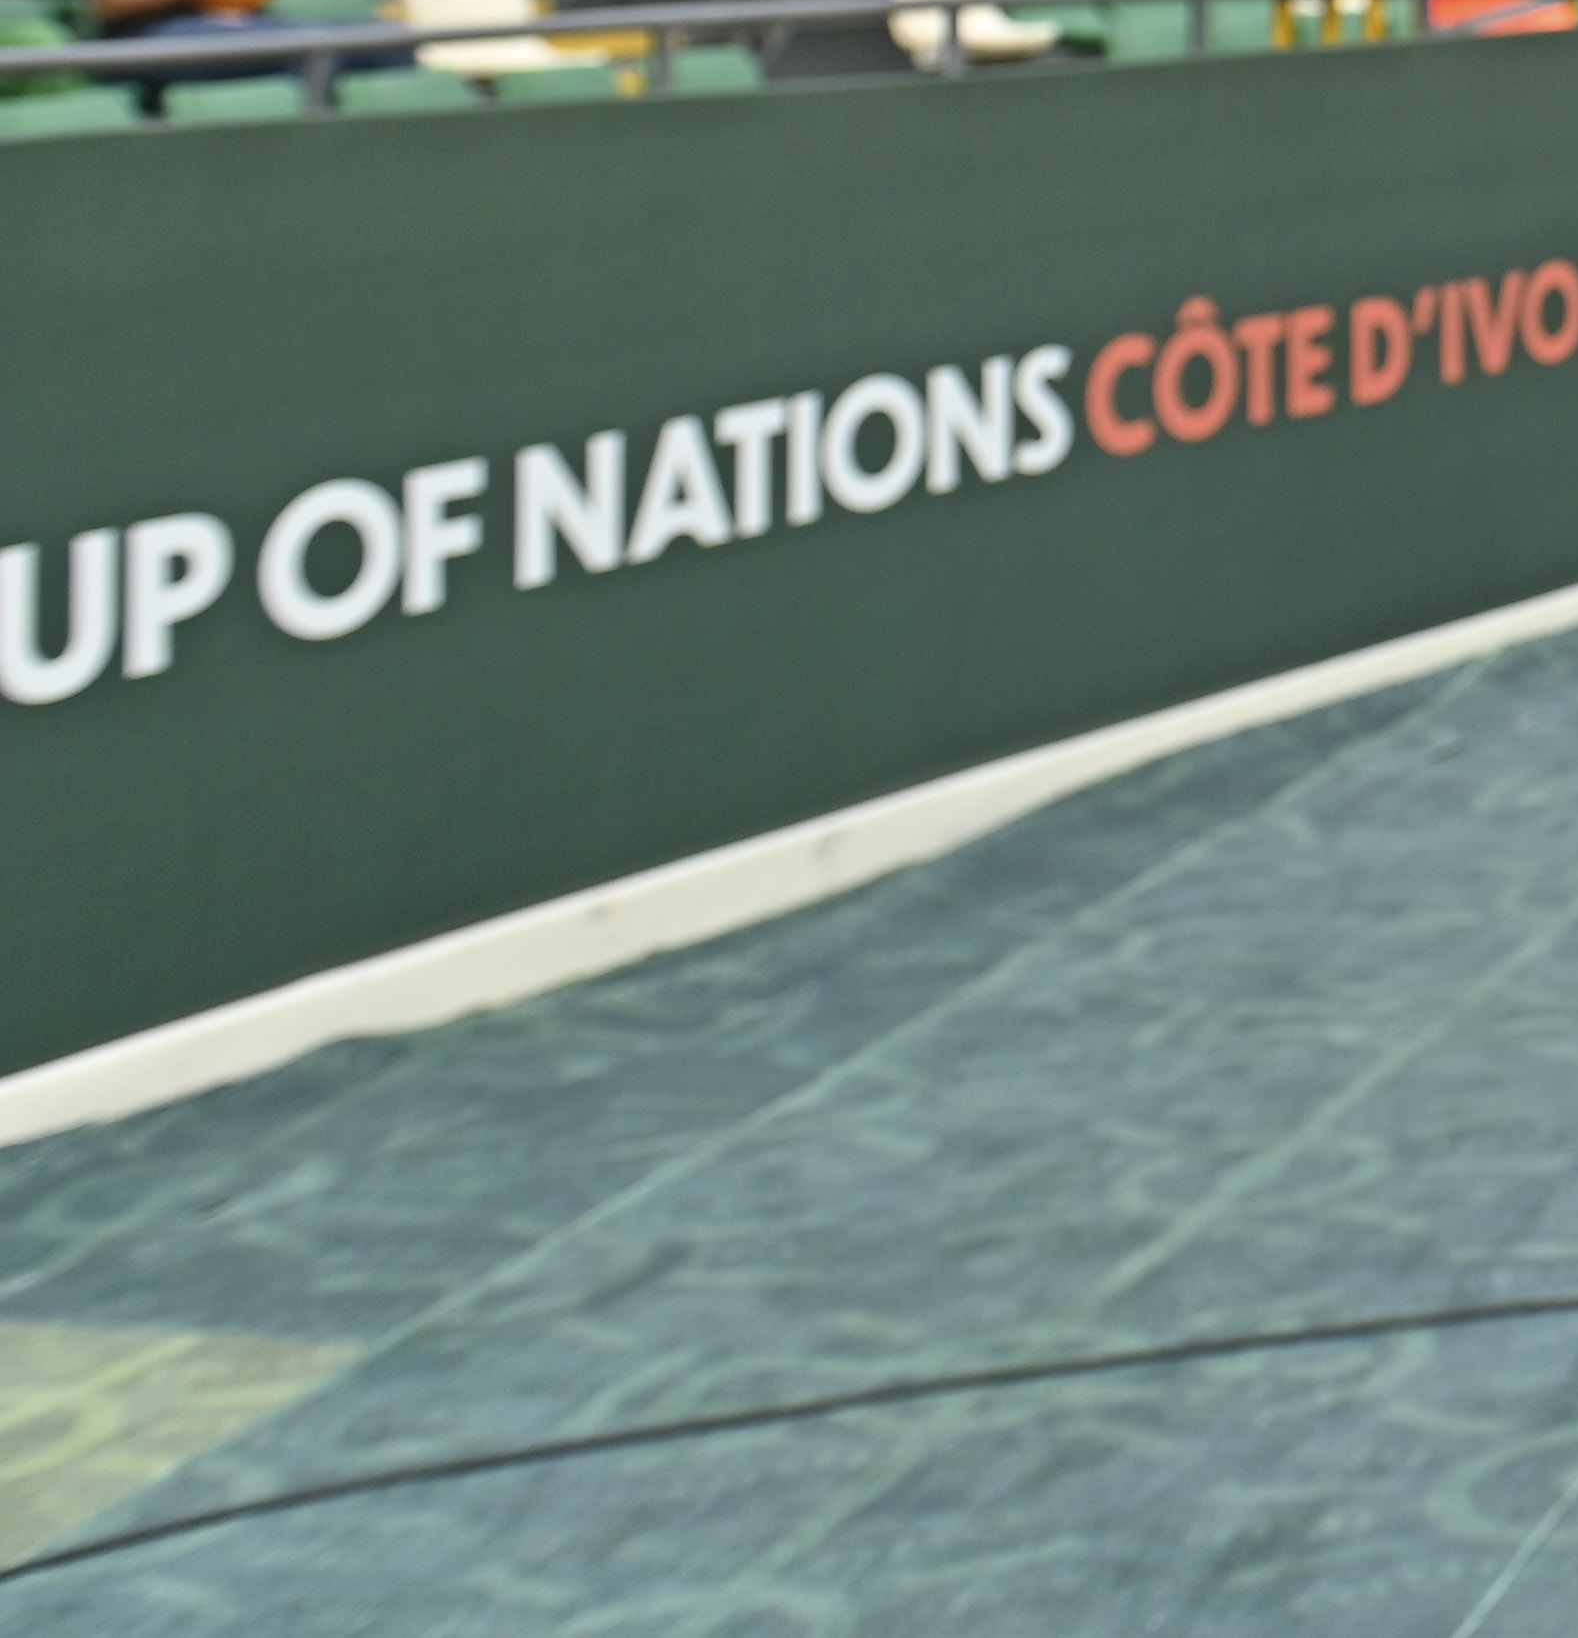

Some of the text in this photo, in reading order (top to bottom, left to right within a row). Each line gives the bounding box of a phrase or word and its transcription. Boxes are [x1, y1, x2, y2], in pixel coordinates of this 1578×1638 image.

[0, 512, 234, 705] UP
[257, 457, 488, 640] OF
[513, 343, 1074, 589] NATIONS
[1085, 296, 1336, 455] CÔTE
